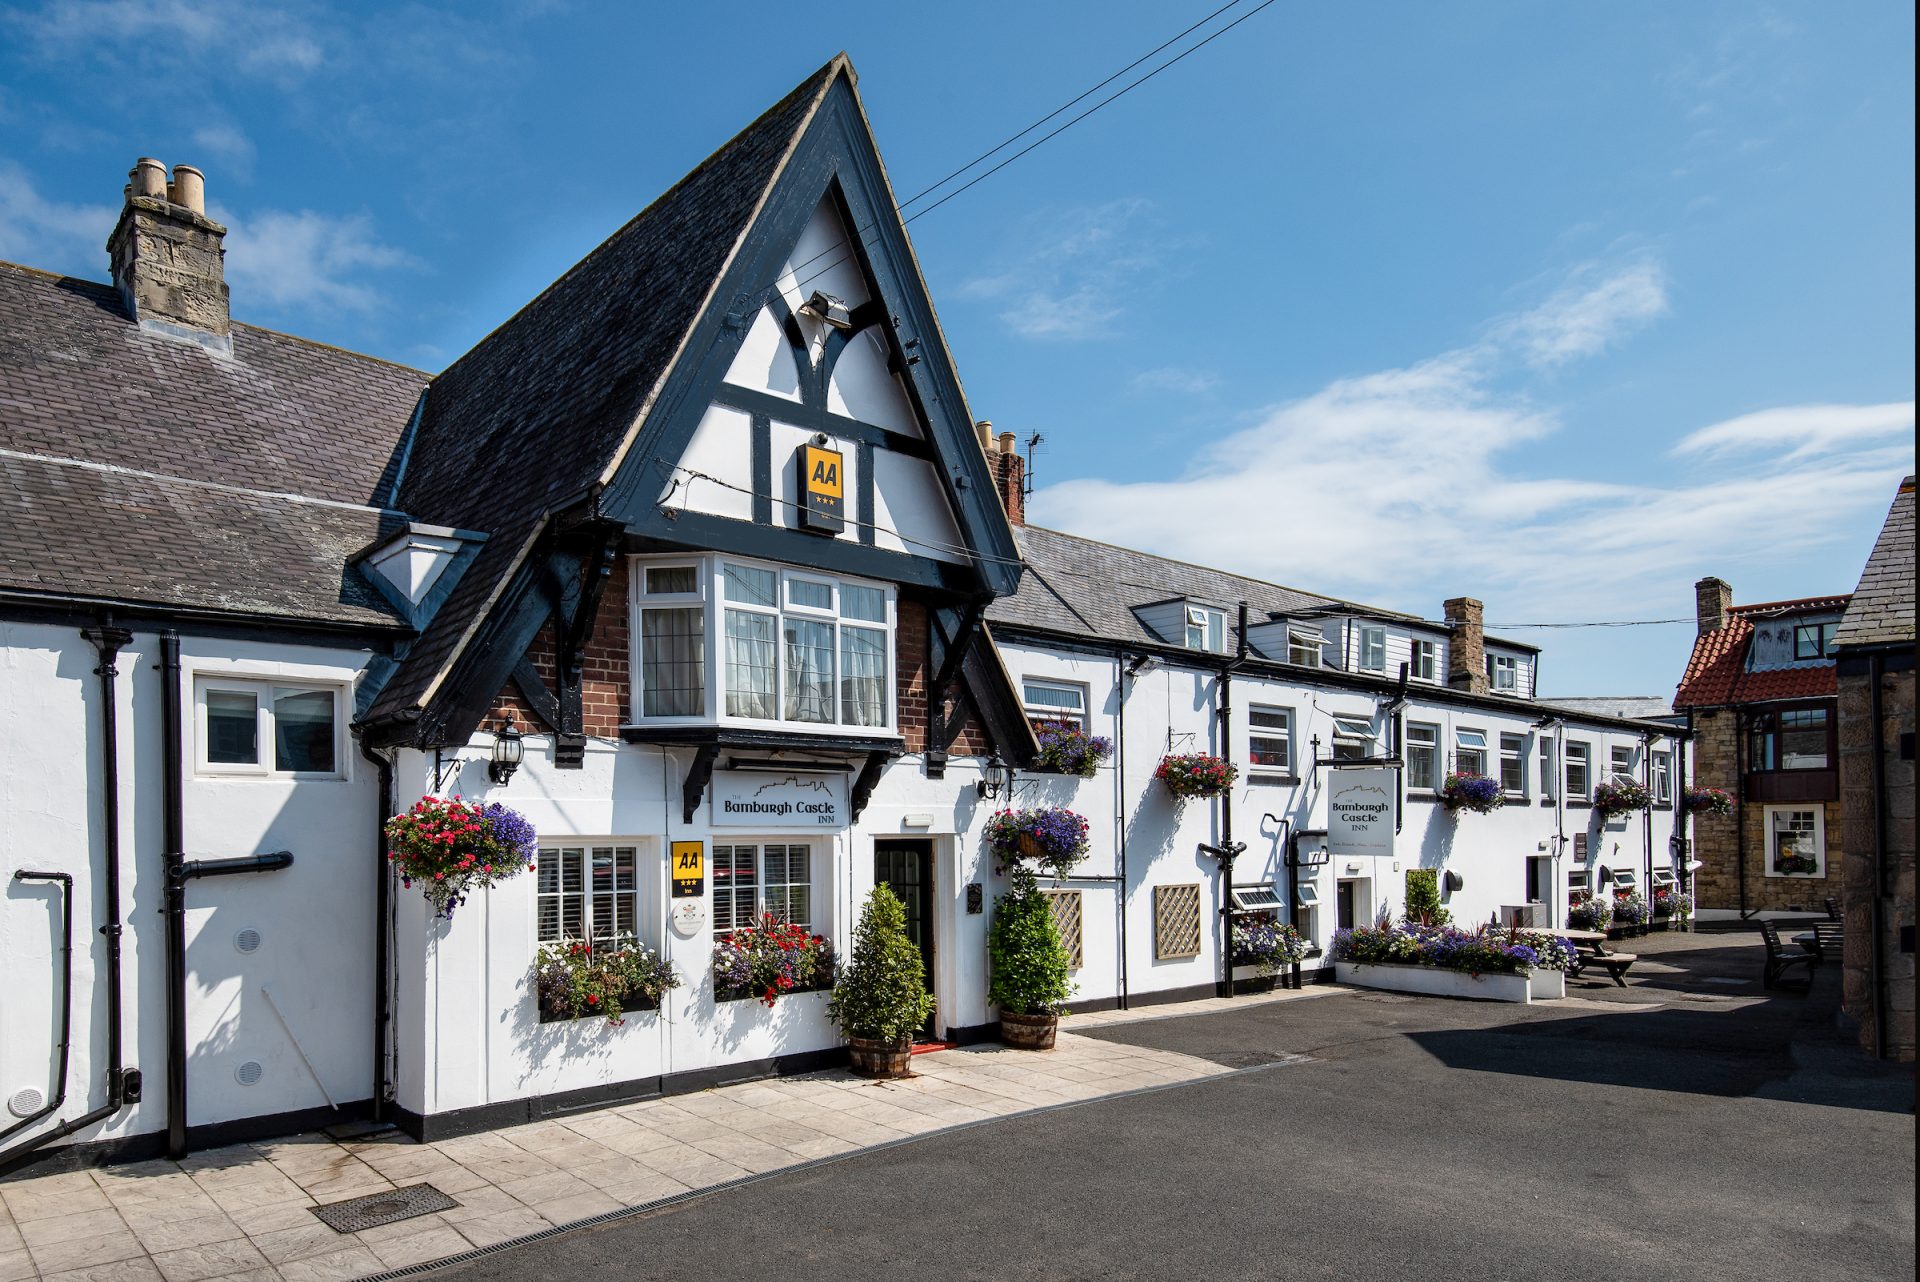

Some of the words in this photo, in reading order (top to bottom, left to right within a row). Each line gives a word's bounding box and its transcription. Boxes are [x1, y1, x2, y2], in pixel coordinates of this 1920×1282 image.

[812, 460, 836, 486] AA
[724, 800, 792, 816] Bamburgh
[796, 801, 835, 814] Castle
[1333, 803, 1388, 813] Bamburgh
[818, 815, 835, 824] INN
[1341, 813, 1378, 822] Castle
[679, 852, 698, 869] AA
